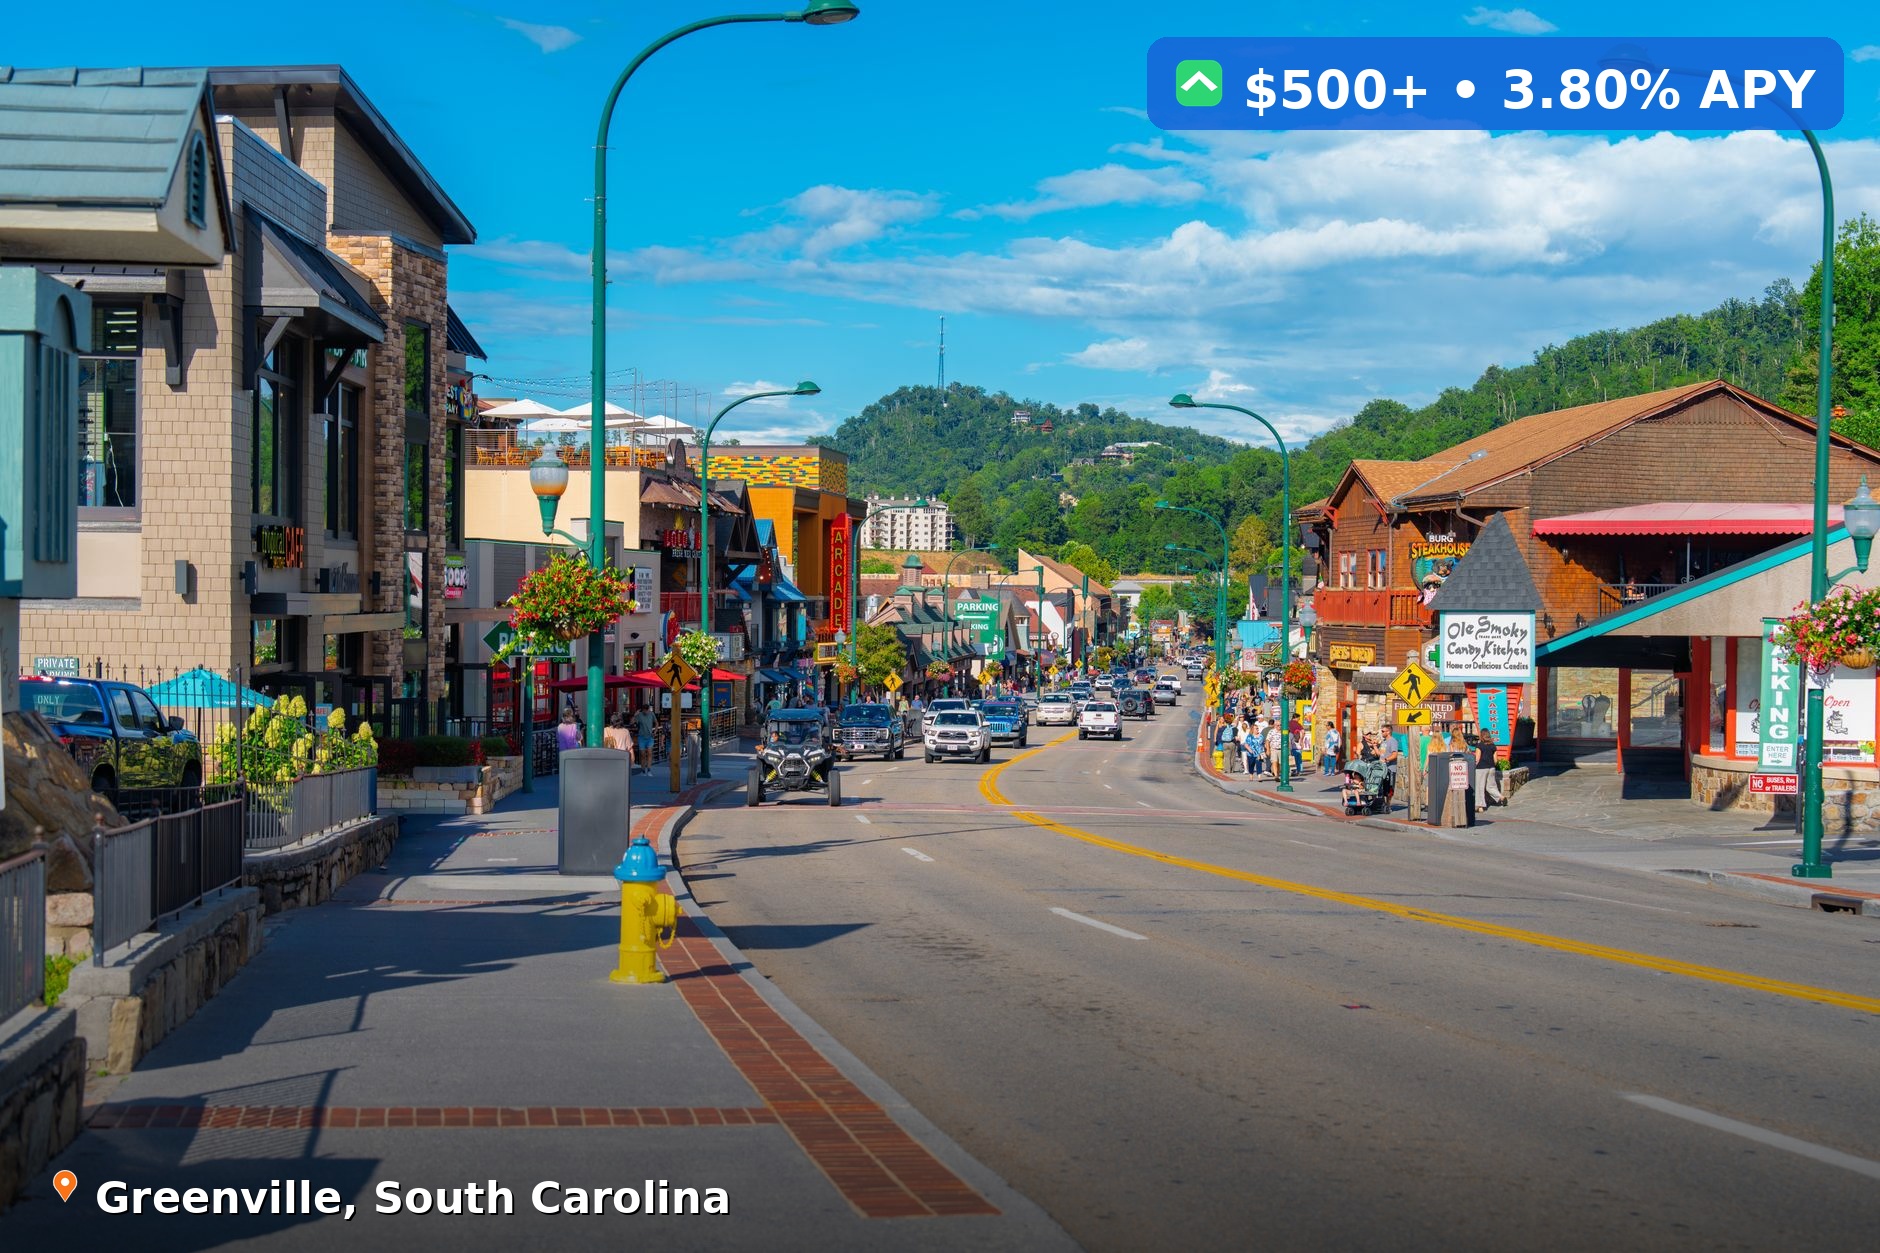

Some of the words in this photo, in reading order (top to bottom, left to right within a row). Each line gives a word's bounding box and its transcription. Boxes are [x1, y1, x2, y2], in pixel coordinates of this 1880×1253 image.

[1428, 534, 1454, 543] BURG
[285, 527, 304, 569] CAFE
[1411, 542, 1471, 559] STEAKHOUSE
[834, 531, 843, 627] ARCADE
[957, 602, 999, 611] PARKING
[1447, 621, 1475, 640] Ole
[1475, 615, 1528, 645] Smoky
[1447, 642, 1481, 662] Candy
[1481, 640, 1528, 662] Kitchen
[37, 657, 75, 669] PRIVATE
[1446, 661, 1463, 669] Home
[1472, 661, 1502, 670] Delicious
[1503, 662, 1529, 670] Candies
[37, 695, 60, 705] ONLY
[1824, 695, 1850, 708] Open
[1394, 702, 1408, 710] FIR
[1420, 703, 1453, 712] UNITED
[1488, 695, 1500, 743] PARKING
[1752, 779, 1763, 789] NO
